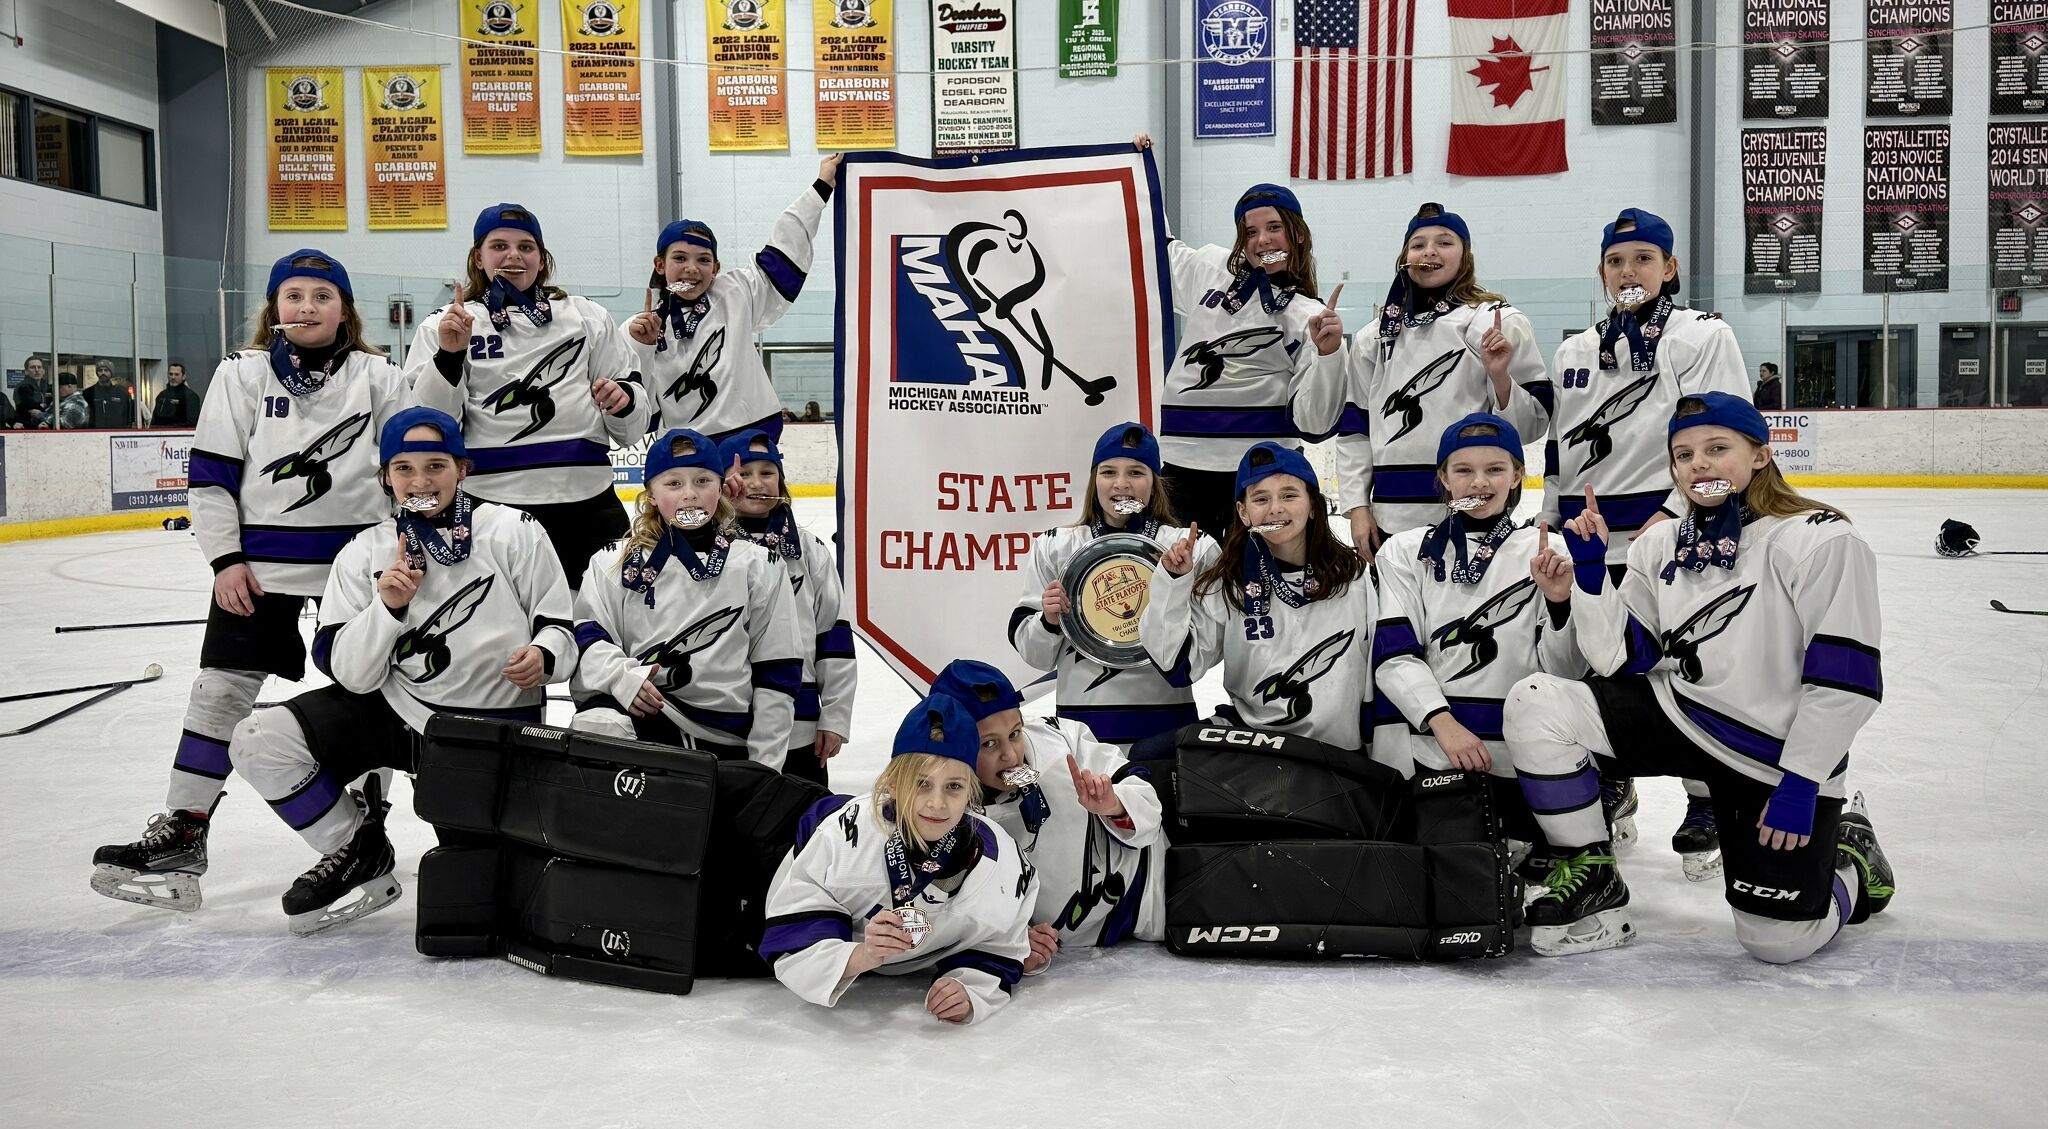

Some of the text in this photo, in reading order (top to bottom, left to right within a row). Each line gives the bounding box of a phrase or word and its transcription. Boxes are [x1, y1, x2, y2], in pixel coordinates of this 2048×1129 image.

[938, 2, 1001, 21] Dearborn
[1213, 4, 1257, 18] DEARBORN
[1594, 0, 1672, 13] NATIONAL
[1994, 4, 2048, 20] CHAMPI
[1594, 13, 1671, 30] CHAMPIONS
[1747, 10, 1826, 27] CHAMPIONS
[1870, 7, 1950, 24] CHAMPIONS
[956, 23, 988, 31] UNIFIED
[600, 42, 635, 50] LCAHL
[722, 44, 770, 52] DIVISION
[951, 41, 995, 53] VARSITY
[571, 60, 635, 68] CHAMPIONS
[715, 53, 779, 61] CHAMPIONS
[822, 53, 886, 61] CHAMPIONS
[938, 57, 1009, 70] HOCKEY TEAM
[1070, 53, 1106, 62] CHAMPIONS
[472, 82, 532, 91] DEARBORN
[579, 83, 628, 91] DEARBORN
[718, 75, 777, 85] DEARBORN
[820, 78, 889, 89] DEARBORN
[948, 77, 1000, 85] FORDSON
[472, 92, 533, 102] MUSTANGS
[566, 93, 641, 102] MUSTANGS BLUE
[717, 85, 778, 96] MUSTANGS
[819, 91, 890, 101] MUSTANGS
[488, 103, 518, 112] BLUE
[728, 96, 767, 106] SILVER
[944, 98, 1005, 106] DEARBORN
[303, 118, 338, 126] LCAHL
[275, 135, 338, 143] CHAMPIONS
[373, 134, 437, 142] CHAMPIONS
[1743, 132, 1825, 150] CRYSTALLETTES
[1866, 130, 1949, 148] CRYSTALLETTES
[281, 154, 333, 162] DEARBORN
[1743, 152, 1825, 166] 2013 JUVENILE
[1871, 150, 1943, 164] 2013 NOVICE
[1991, 149, 2020, 165] 2014
[278, 164, 309, 172] BELLE
[374, 162, 437, 172] DEARBORN
[281, 173, 334, 181] MUSTANGS
[378, 173, 434, 182] OUTLAWS
[1746, 168, 1824, 184] NATIONAL
[1867, 167, 1947, 182] NATIONAL
[1990, 169, 2036, 186] WORLD
[1747, 185, 1824, 202] CHAMPIONS
[1867, 184, 1947, 200] CHAMPIONS
[1199, 289, 1226, 309] 16
[2003, 298, 2017, 311] EXIT
[900, 237, 1008, 386] MAHA
[1661, 301, 1672, 317] 2025
[470, 335, 504, 360] 22
[1563, 368, 1590, 388] 88
[889, 387, 1029, 403] MICHIGAN AMATEUR
[264, 396, 290, 418] 19
[889, 399, 1042, 415] HOCKEY ASSOCIATION
[129, 493, 188, 505] (313) 244-9800
[938, 472, 1073, 513] STATE
[463, 497, 471, 512] 2025
[1498, 525, 1511, 539] 2025
[880, 530, 1041, 571] CHAMP
[713, 558, 724, 574] 2025
[1660, 560, 1677, 585] 4
[1095, 581, 1147, 609] STATE PLAYOFFS
[1269, 573, 1300, 608] CHAMPION
[1280, 581, 1295, 597] 2025
[644, 587, 655, 609] 4
[1123, 619, 1137, 628] GIRLS
[1244, 616, 1275, 640] 23
[1198, 727, 1286, 750] CCM
[943, 836, 957, 854] 2025
[886, 842, 897, 867] 2025
[1732, 878, 1801, 902] CCM
[1187, 926, 1281, 944] CCM
